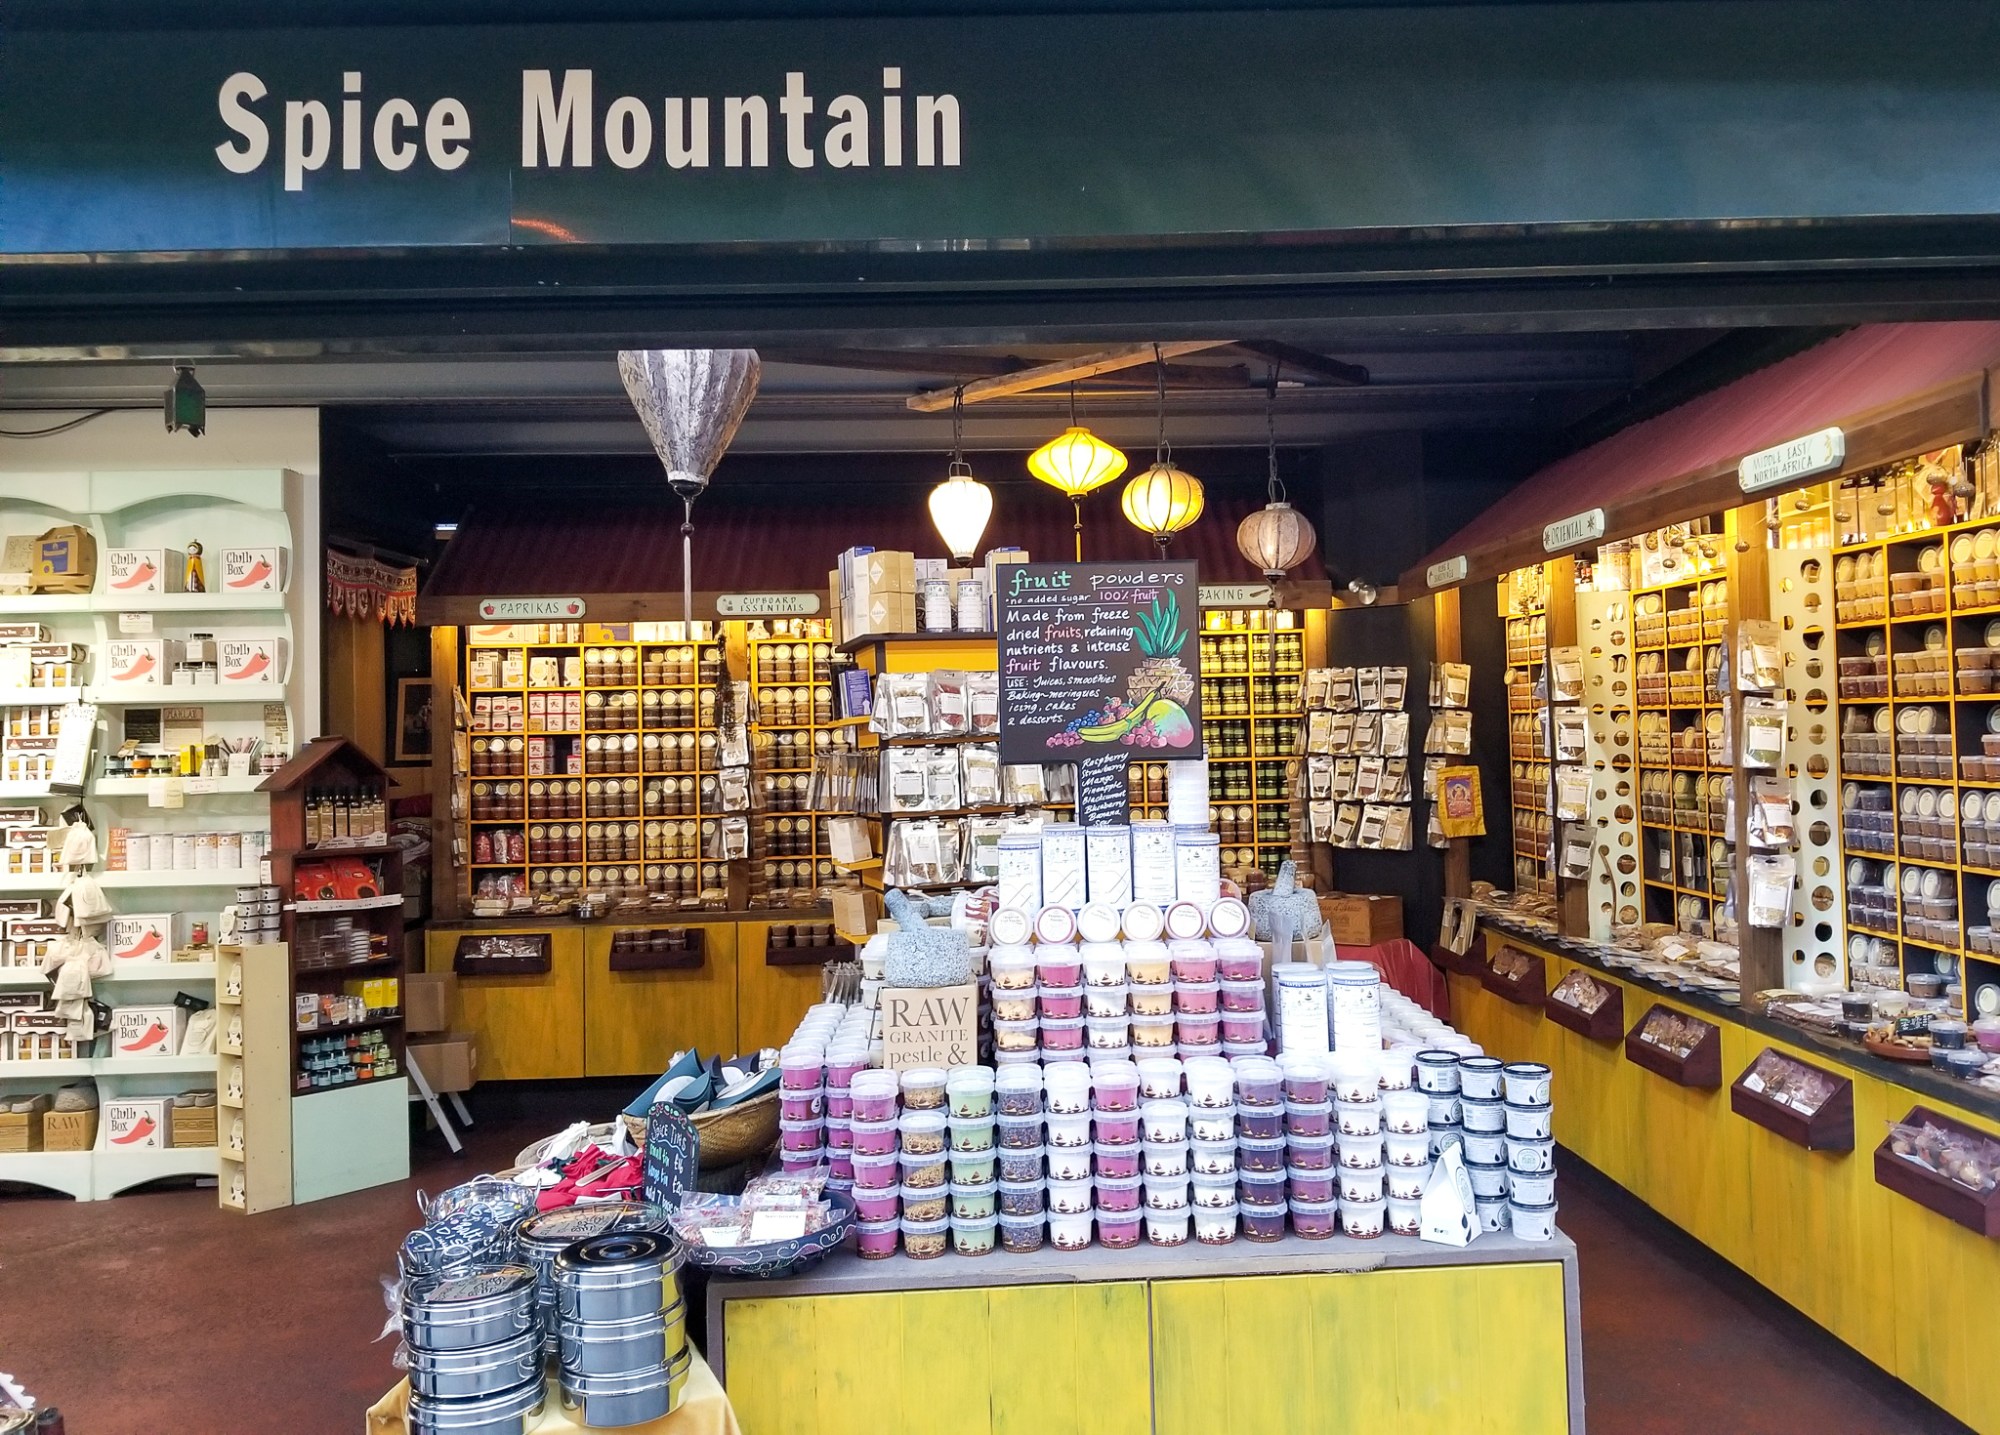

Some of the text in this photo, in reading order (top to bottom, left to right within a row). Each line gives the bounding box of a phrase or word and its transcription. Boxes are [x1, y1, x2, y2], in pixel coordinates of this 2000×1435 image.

[215, 67, 961, 191] Spice Mountain
[1788, 442, 1807, 460] EAST
[1754, 456, 1813, 484] NORTH AFRICA
[1551, 520, 1583, 545] ORIENTAL
[111, 565, 128, 576] Box
[227, 564, 244, 575] Box
[1009, 569, 1184, 596] fruit powders
[1027, 595, 1058, 604] added
[1061, 594, 1091, 605] sugar
[1100, 591, 1129, 600] 100%
[1131, 589, 1159, 604] fruit
[500, 602, 560, 614] PAPRIKAS
[740, 604, 804, 612] ESSENTIALS
[1006, 607, 1130, 626] Made from freeze
[1006, 624, 1134, 642] dried fruits, retaining
[1006, 643, 1064, 656] nutrients
[1087, 641, 1131, 652] intense
[111, 657, 128, 668] Box
[225, 656, 242, 667] Box
[1006, 656, 1109, 675] fruit flavours.
[1007, 678, 1029, 688] USE:
[1067, 674, 1117, 685] smoothies
[1045, 700, 1077, 711] cakes
[1019, 713, 1066, 725] desserts.
[1081, 752, 1129, 769] Raspberry
[1081, 763, 1126, 779] Strawberry
[1081, 775, 1114, 787] Mango
[1081, 781, 1123, 797] Pineapple
[1084, 799, 1126, 815] Blueberry
[1088, 810, 1121, 821] Banana
[115, 934, 133, 946] Box
[889, 997, 970, 1027] RAW
[120, 1014, 147, 1027] Chilli
[120, 1027, 139, 1039] Box
[890, 1029, 968, 1043] GRANITE
[889, 1043, 969, 1069] pestle &
[110, 1108, 136, 1119] Chilli
[47, 1116, 82, 1130] RAW
[111, 1120, 128, 1132] Box
[673, 1175, 683, 1196] £20
